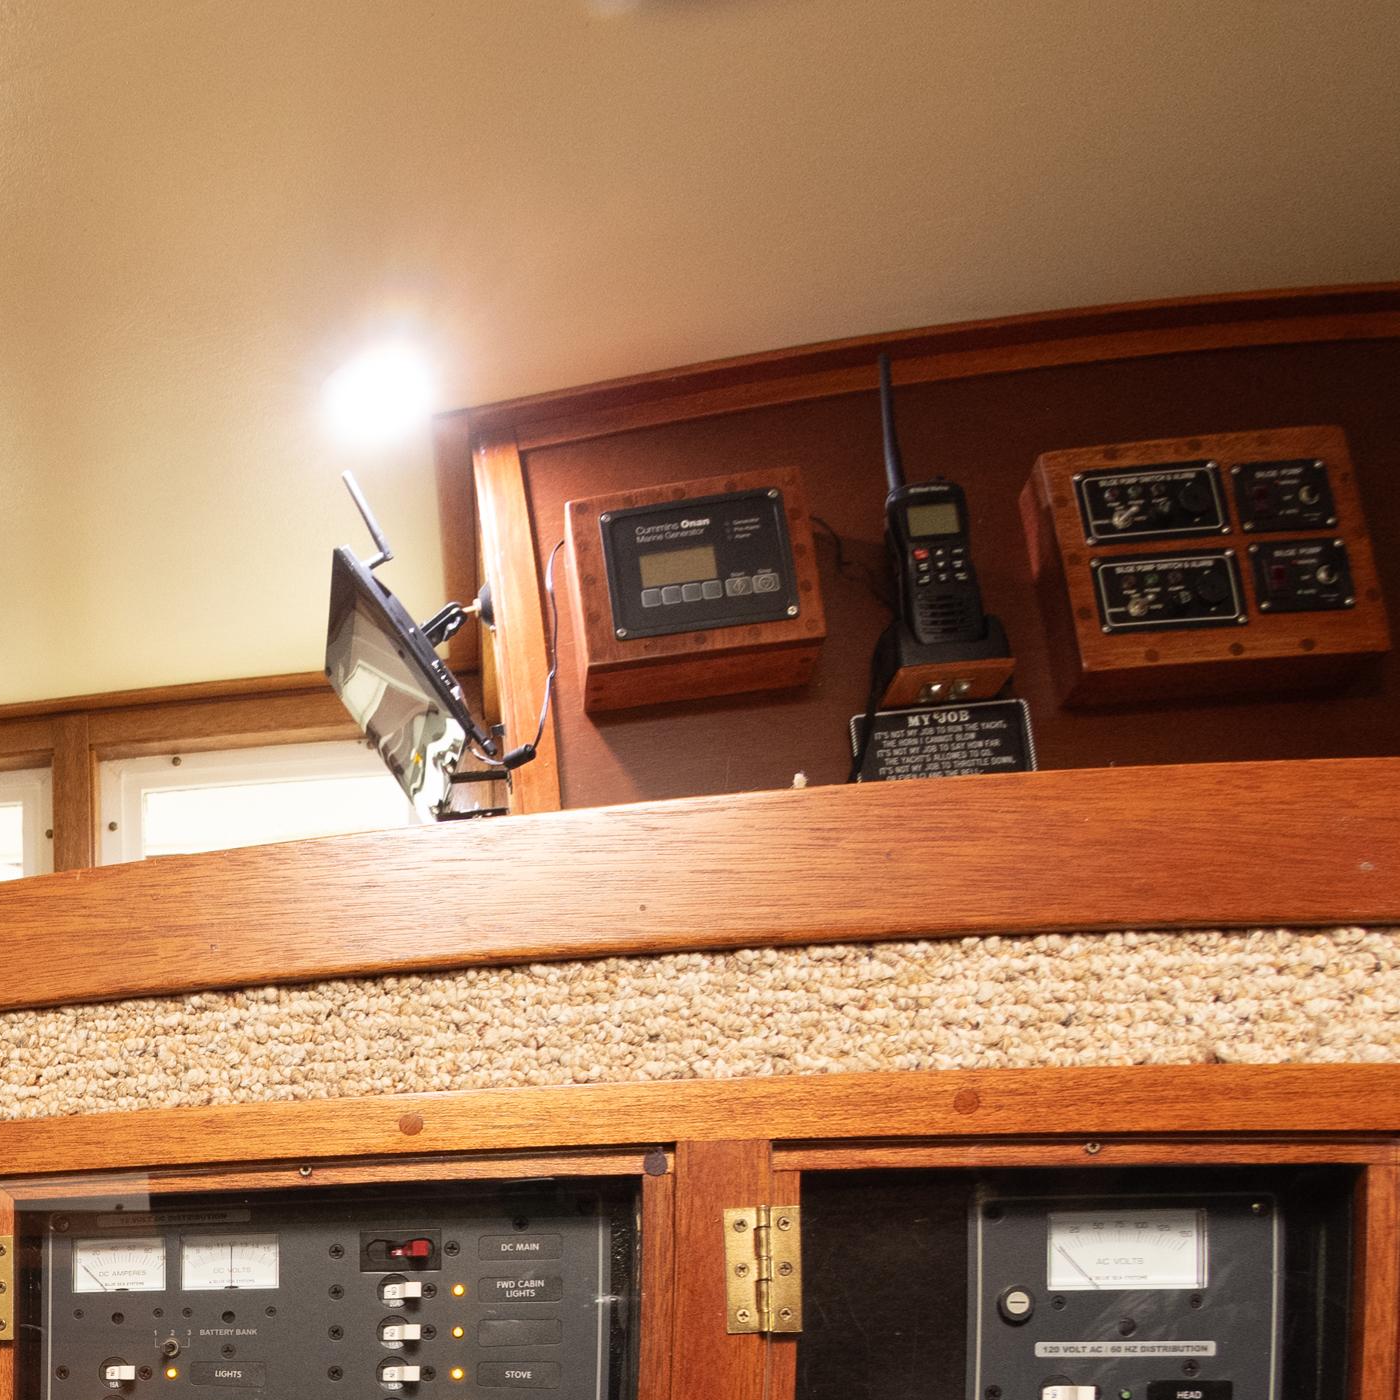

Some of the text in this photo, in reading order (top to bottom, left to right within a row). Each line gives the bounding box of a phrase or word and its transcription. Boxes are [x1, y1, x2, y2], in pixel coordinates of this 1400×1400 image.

[635, 518, 710, 536] Cummins Onan
[636, 528, 705, 544] Marine Generator
[908, 710, 970, 726] MY JOB
[906, 728, 918, 737] MY
[920, 727, 934, 736] JOB
[909, 746, 920, 754] MY
[922, 744, 937, 754] JOB
[911, 764, 922, 772] MY
[924, 762, 940, 771] JOB
[501, 1242, 540, 1251] DC MAIN
[1114, 1257, 1144, 1265] VOLTS
[227, 1266, 252, 1274] VOLTS
[496, 1280, 544, 1288] FWD CABIN
[506, 1290, 536, 1298] LIGHTS
[236, 1328, 258, 1336] BANK
[1043, 1344, 1208, 1354] 120 VOLT AC 60 HZ DISTRIBUTION
[215, 1370, 242, 1378] LIGHTS
[505, 1370, 532, 1378] STOVE
[1176, 1391, 1202, 1399] HEAD
